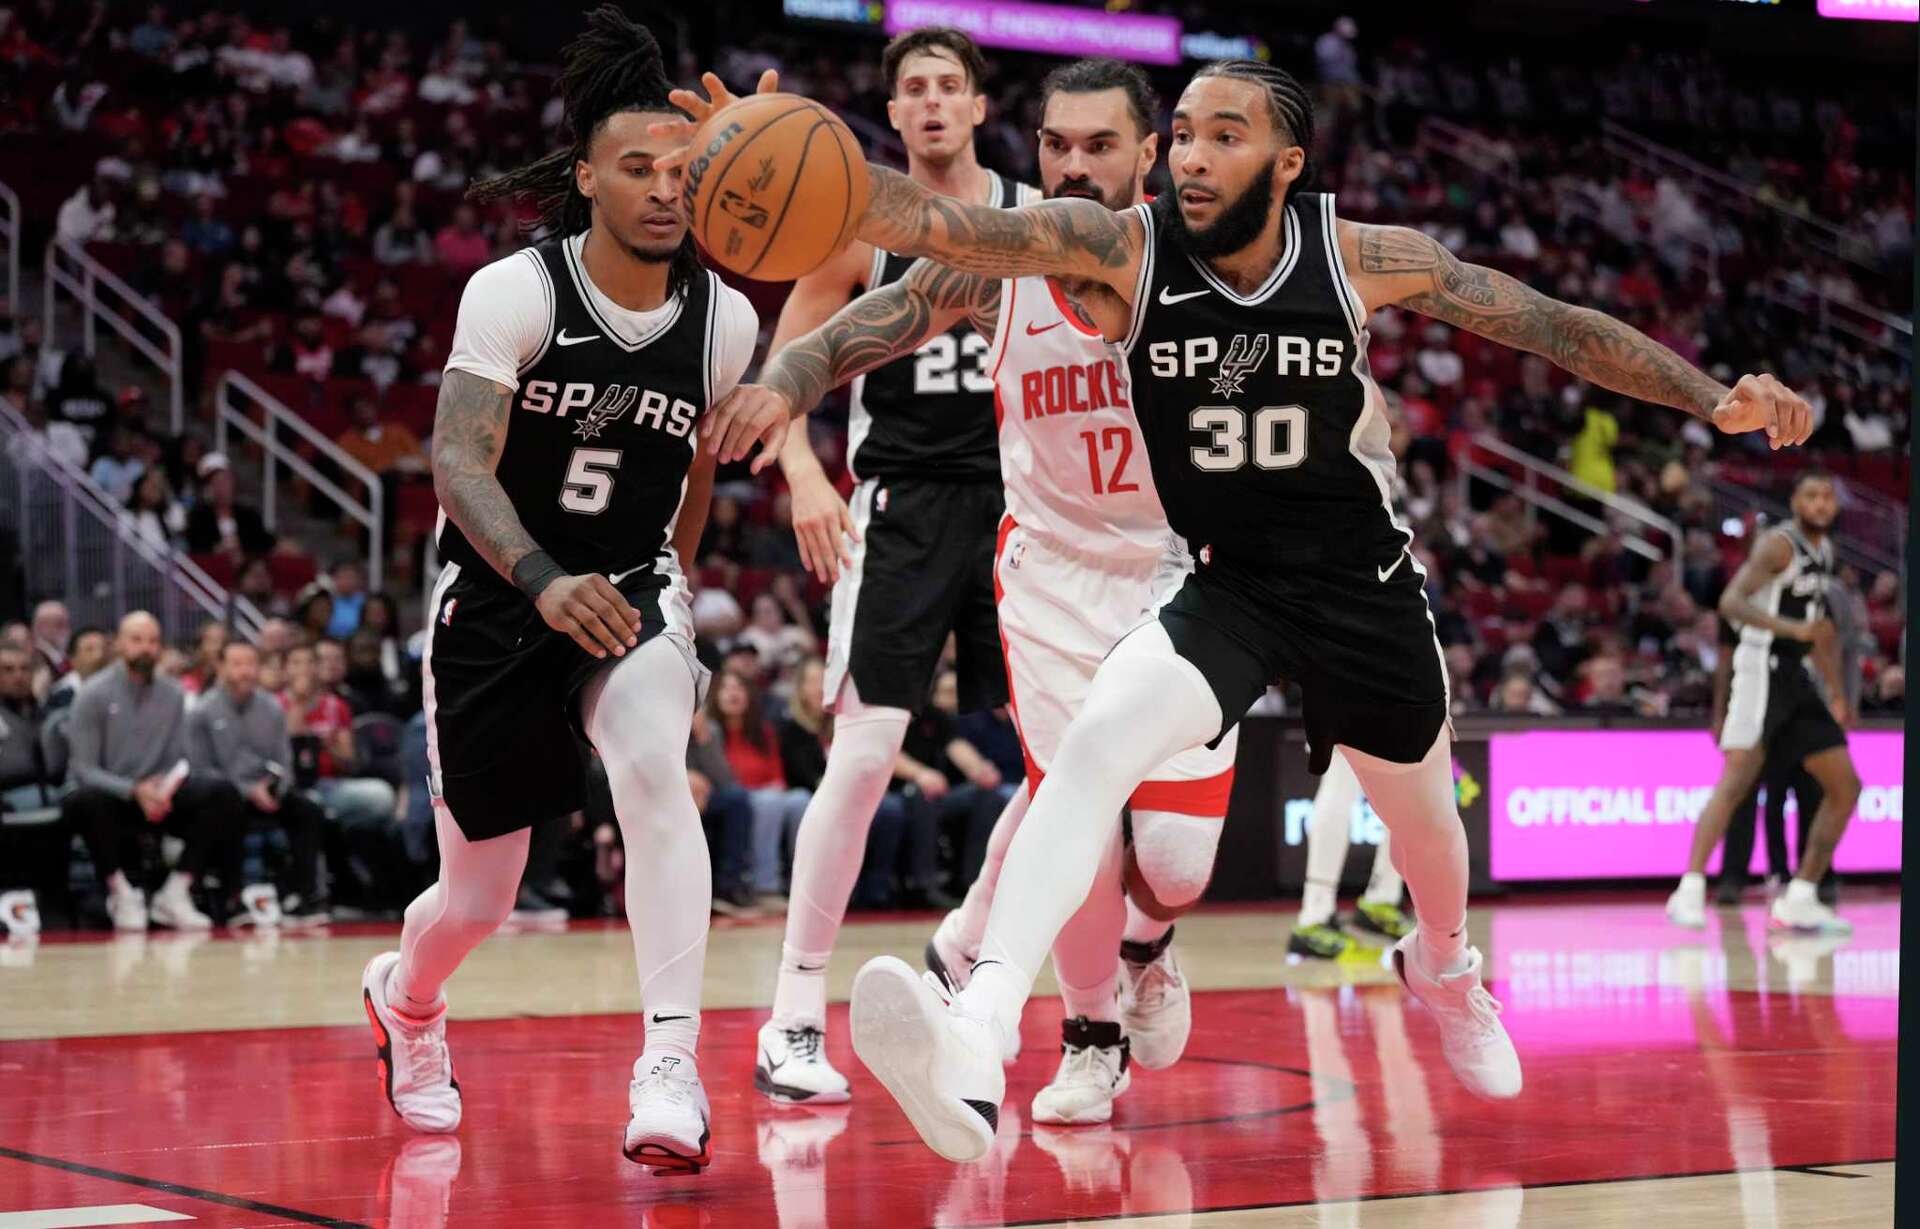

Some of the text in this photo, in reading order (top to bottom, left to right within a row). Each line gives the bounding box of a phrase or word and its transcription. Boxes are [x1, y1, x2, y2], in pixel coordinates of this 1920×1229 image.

[914, 333, 995, 394] 23
[1080, 427, 1139, 495] 12
[1189, 404, 1310, 471] 30
[558, 447, 623, 516] 5
[1506, 786, 1652, 827] OFFICIAL
